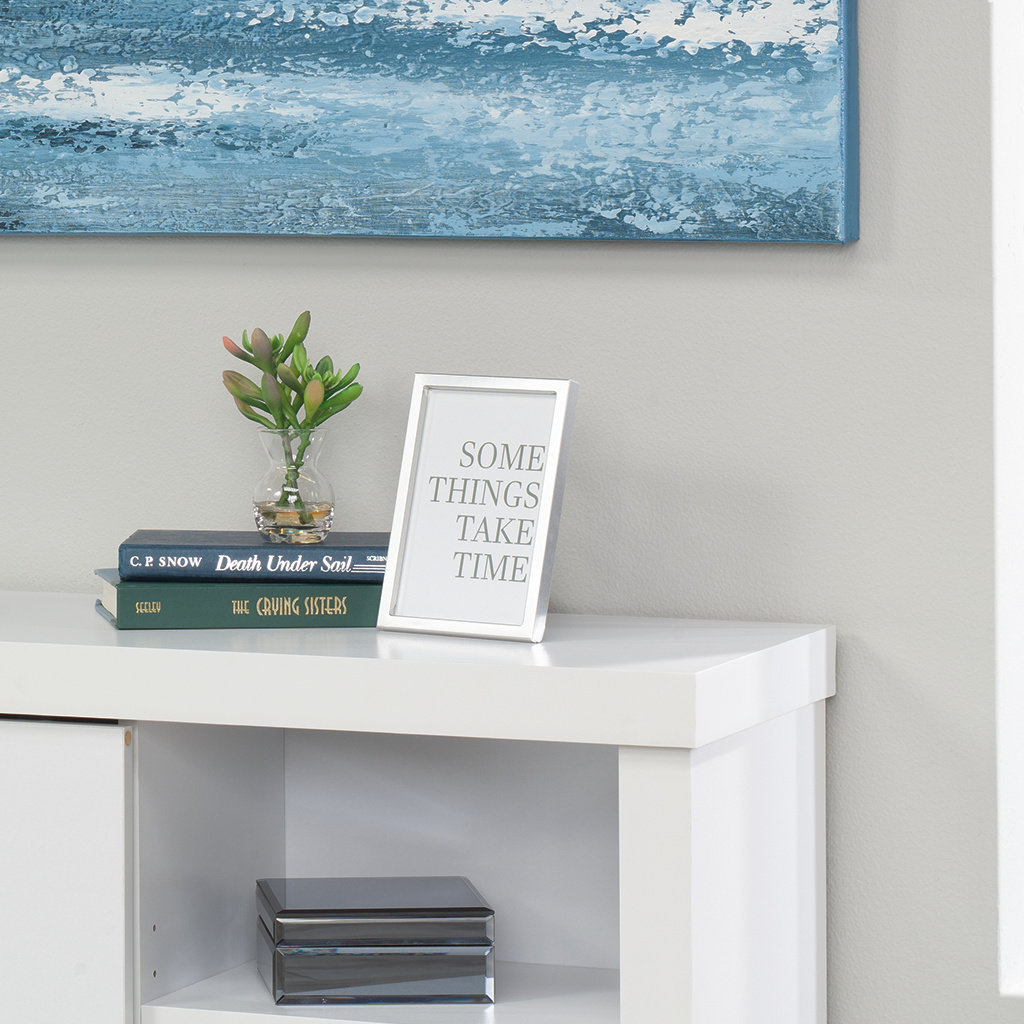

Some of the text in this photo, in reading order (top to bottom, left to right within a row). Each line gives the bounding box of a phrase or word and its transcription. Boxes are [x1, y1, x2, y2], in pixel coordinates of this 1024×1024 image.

[459, 440, 546, 472] SOME
[428, 476, 540, 509] THINGS
[456, 514, 535, 546] TAKE
[129, 556, 203, 567] C. P. SNOW
[215, 555, 353, 573] Death Under Sail
[453, 551, 529, 583] TIME
[135, 601, 161, 613] SEELEY
[232, 596, 348, 616] THE CRYING SISTERS
